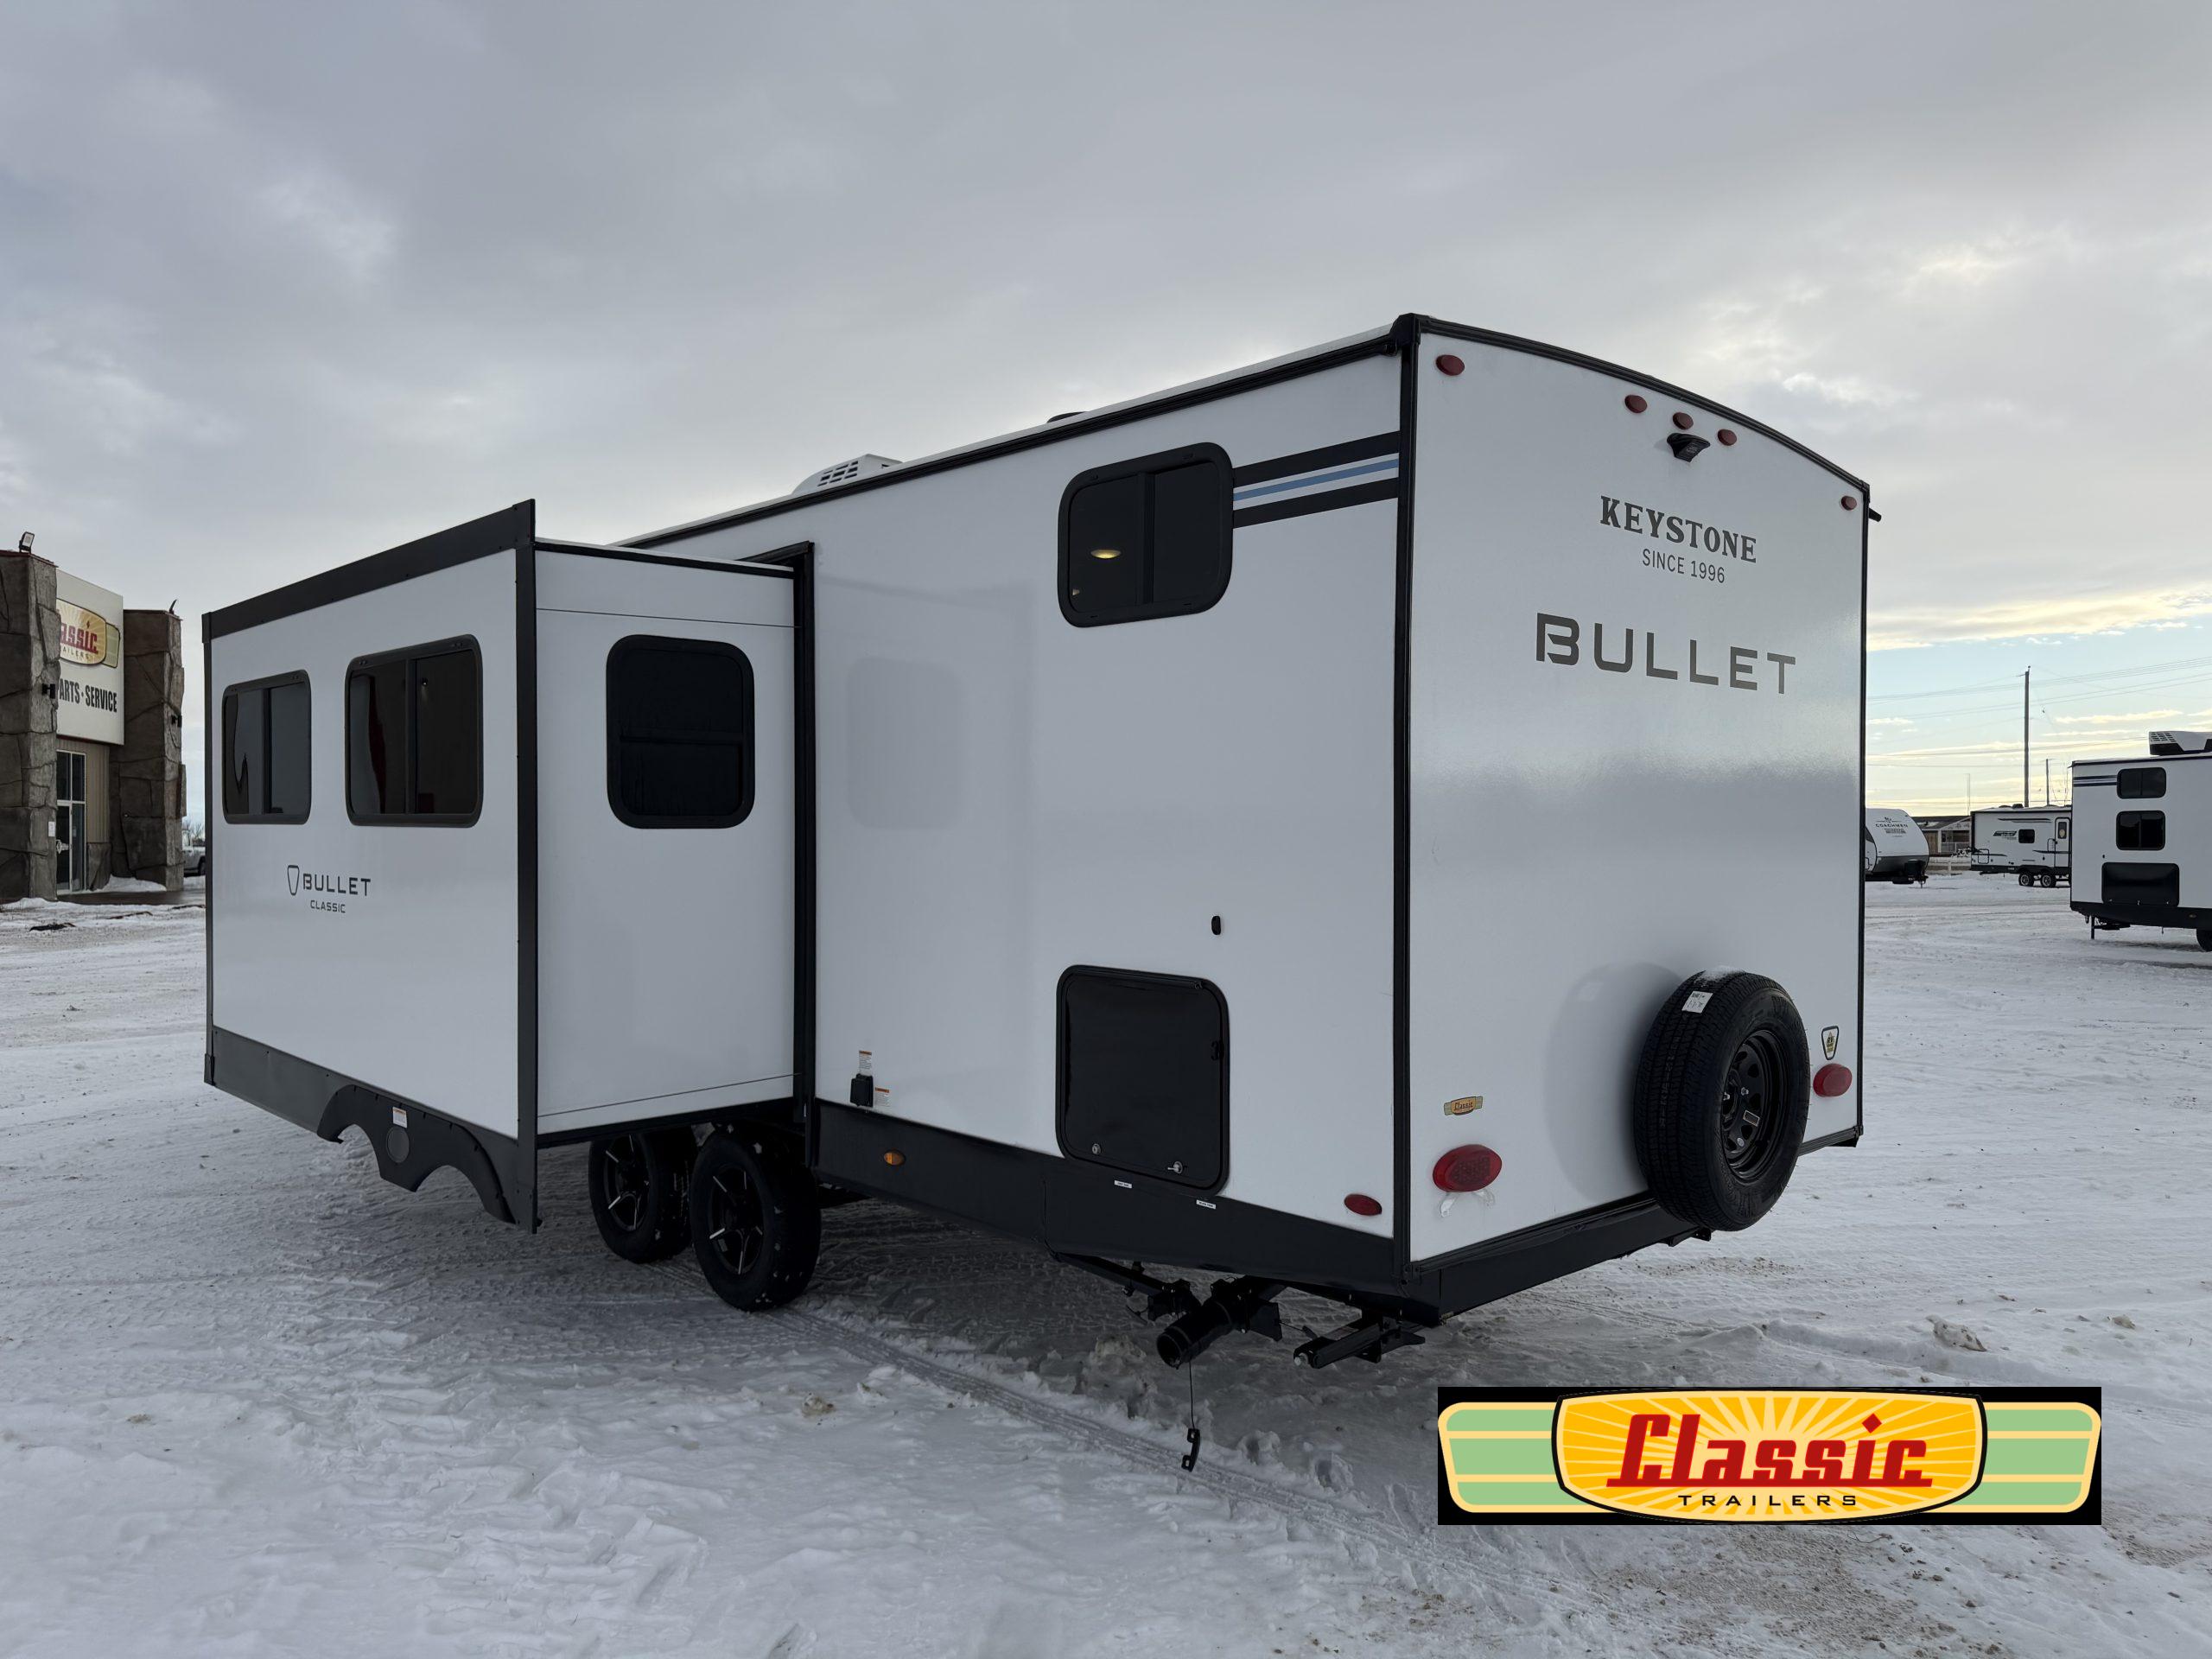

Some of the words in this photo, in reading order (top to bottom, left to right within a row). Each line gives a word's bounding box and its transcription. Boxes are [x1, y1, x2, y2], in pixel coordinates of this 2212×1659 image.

[1600, 495, 1757, 563] KEYSTONE
[1642, 548, 1685, 575] SINCE
[1690, 560, 1726, 584] 1996
[1535, 612, 1796, 695] BULLET
[59, 678, 81, 704] ARTS
[85, 684, 118, 713] SERVICE
[302, 872, 372, 897] BULLET
[310, 899, 346, 913] CLASSIC
